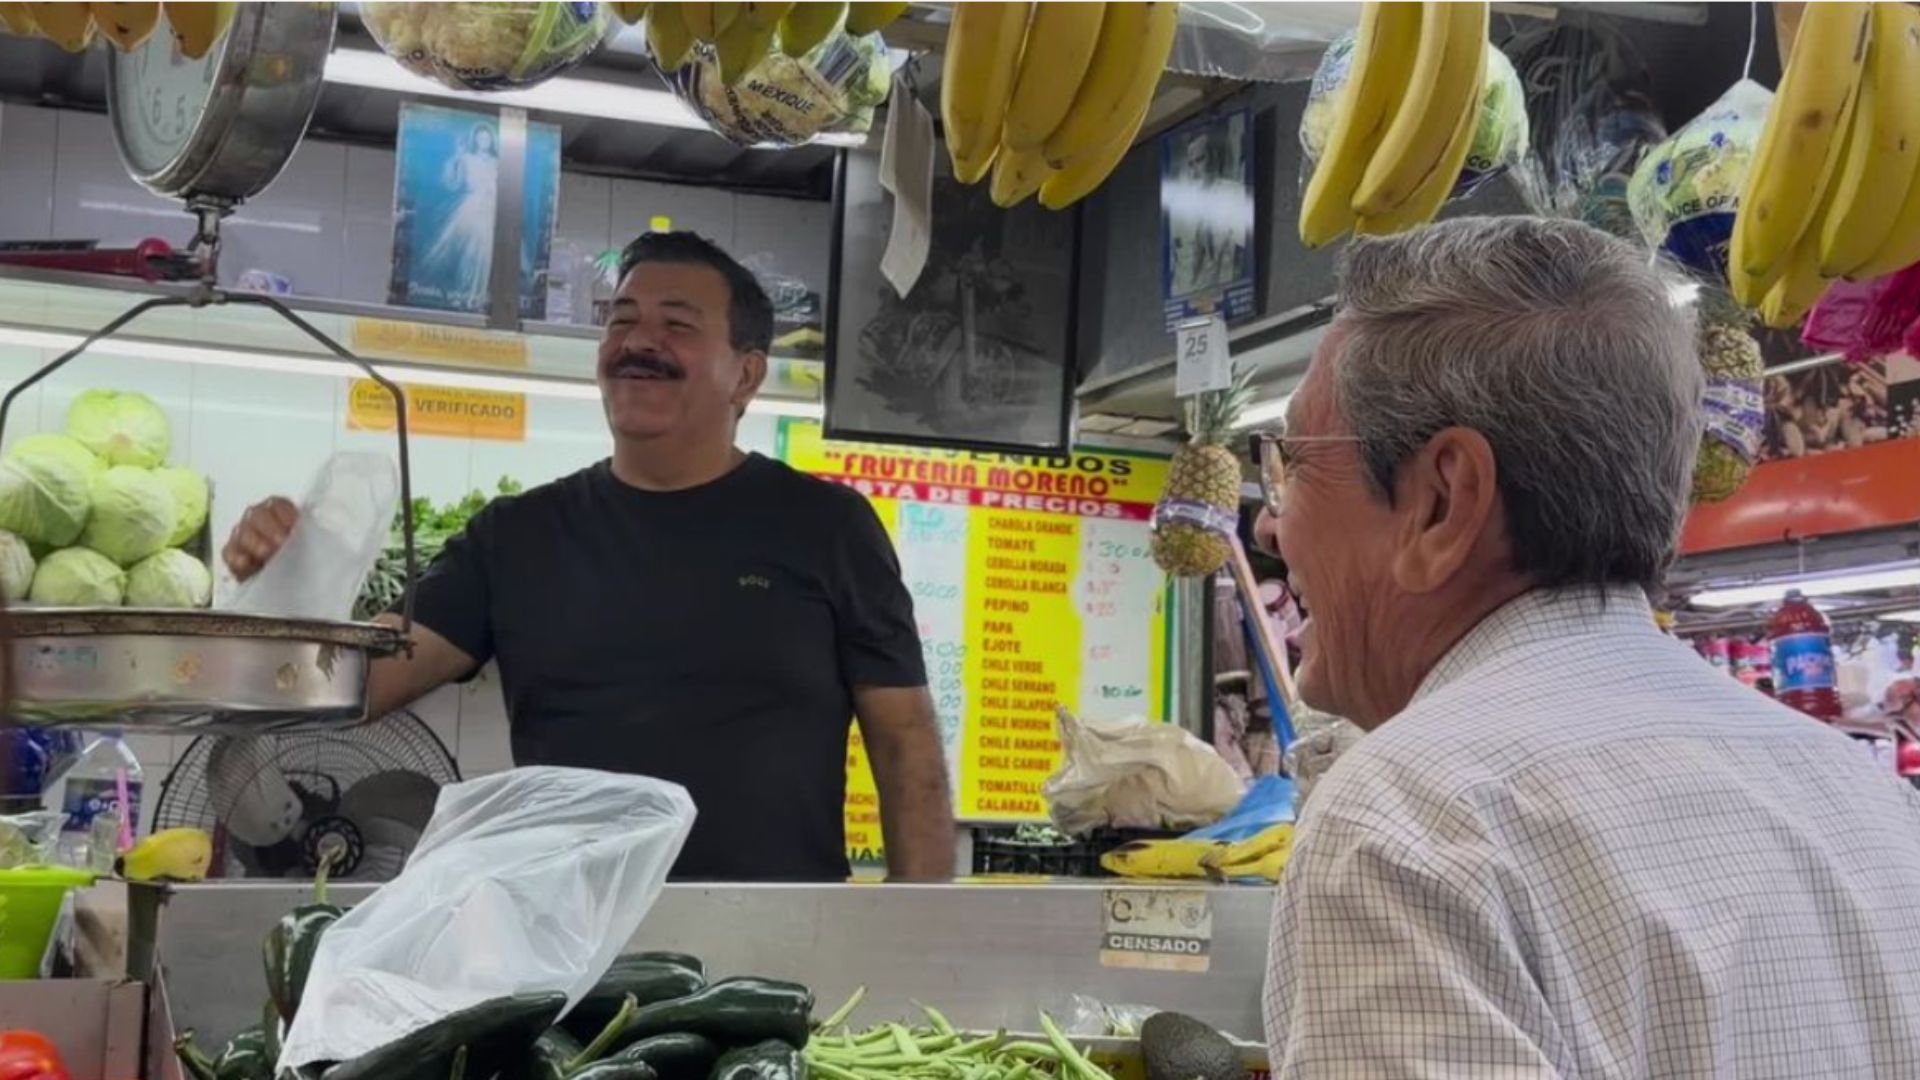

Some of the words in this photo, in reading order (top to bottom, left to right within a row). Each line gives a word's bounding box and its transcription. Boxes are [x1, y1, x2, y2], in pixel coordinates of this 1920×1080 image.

[1467, 155, 1492, 170] CO
[1185, 333, 1208, 359] 25
[415, 398, 515, 419] VERIFICADO
[929, 486, 968, 505] DE
[987, 536, 1035, 553] TOMATE
[1029, 579, 1067, 595] BLANCA
[984, 597, 1030, 613] PEPINO
[983, 620, 1013, 634] PAPA
[982, 637, 1021, 653] EJOTE
[982, 657, 1010, 672] CHILE
[1012, 660, 1044, 675] VERDE
[982, 677, 1009, 691] CHILE
[1011, 678, 1056, 695] SERRANO
[981, 695, 1009, 710] CHILE
[980, 715, 1008, 730] CHILE
[979, 734, 1010, 750] CHILE
[979, 754, 1010, 769] CHILE
[1012, 756, 1051, 773] CARIBE
[978, 779, 1041, 795] TOMATILL
[976, 797, 1041, 814] CALABAZA
[1109, 934, 1201, 954] CENSADO
